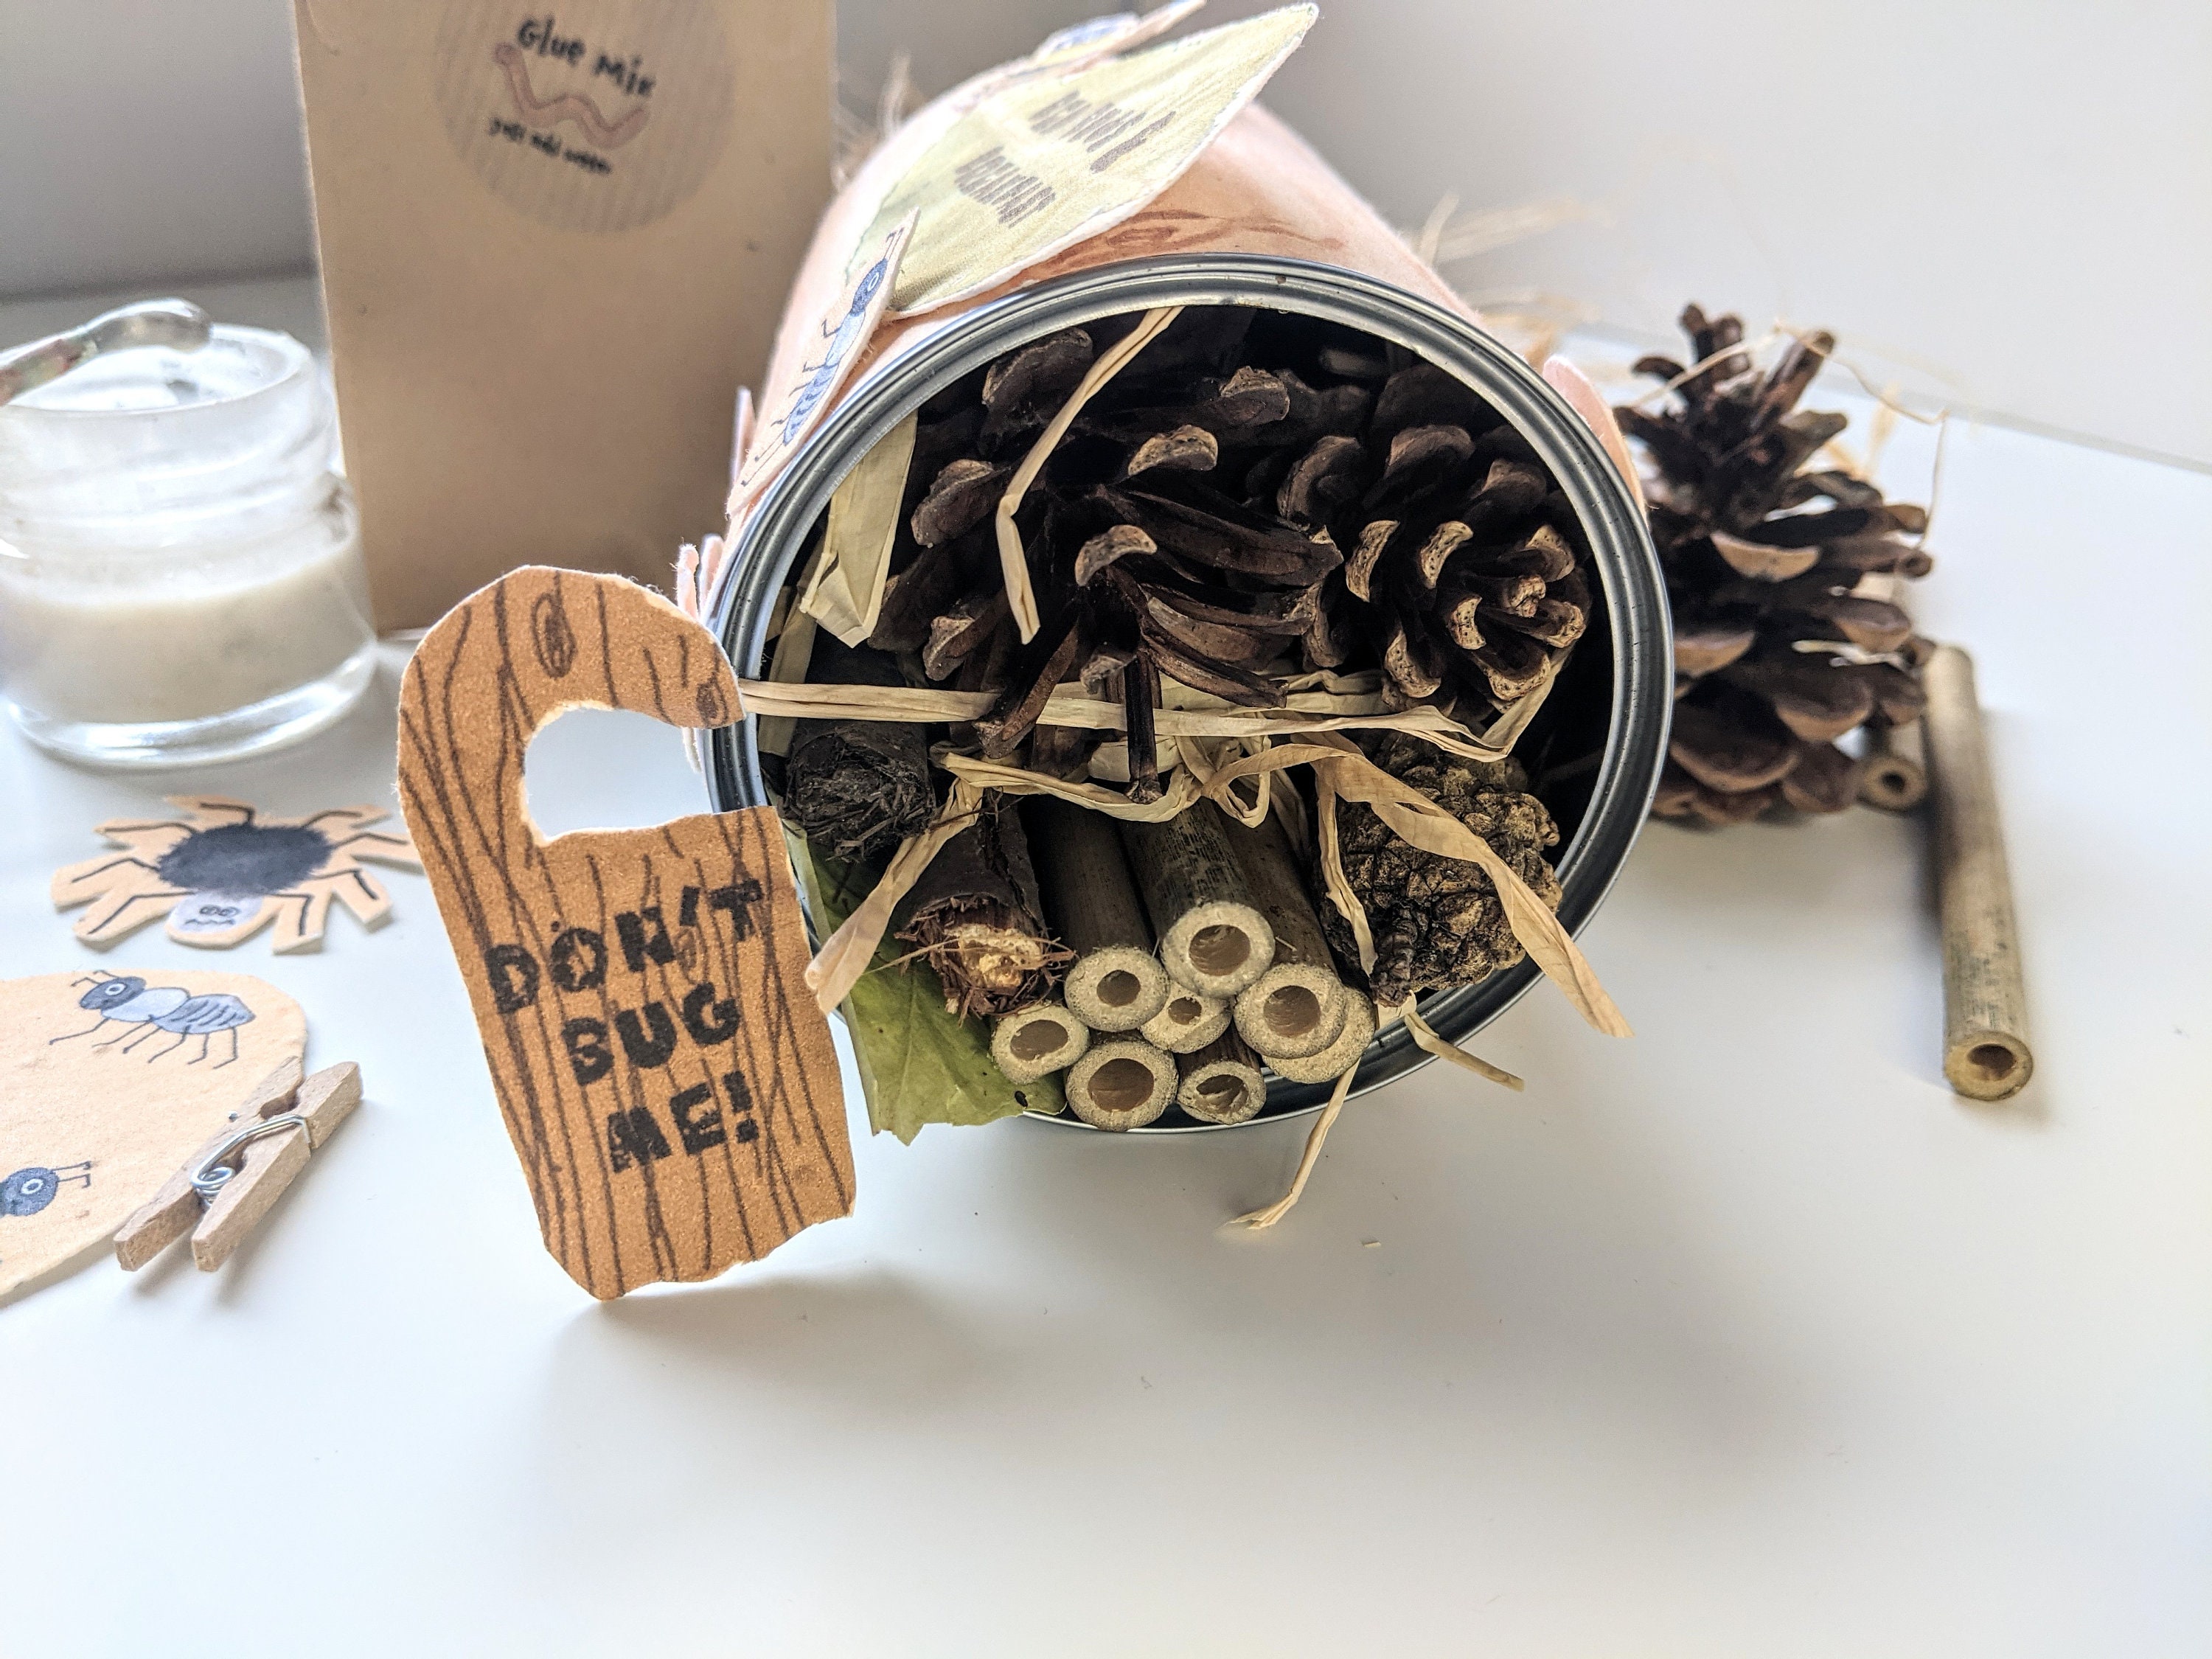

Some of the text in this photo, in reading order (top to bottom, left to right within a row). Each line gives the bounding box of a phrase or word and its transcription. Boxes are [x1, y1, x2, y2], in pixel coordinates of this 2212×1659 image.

[484, 879, 764, 1015] DON'T
[560, 981, 740, 1088] BUG
[607, 1069, 761, 1175] ME!
